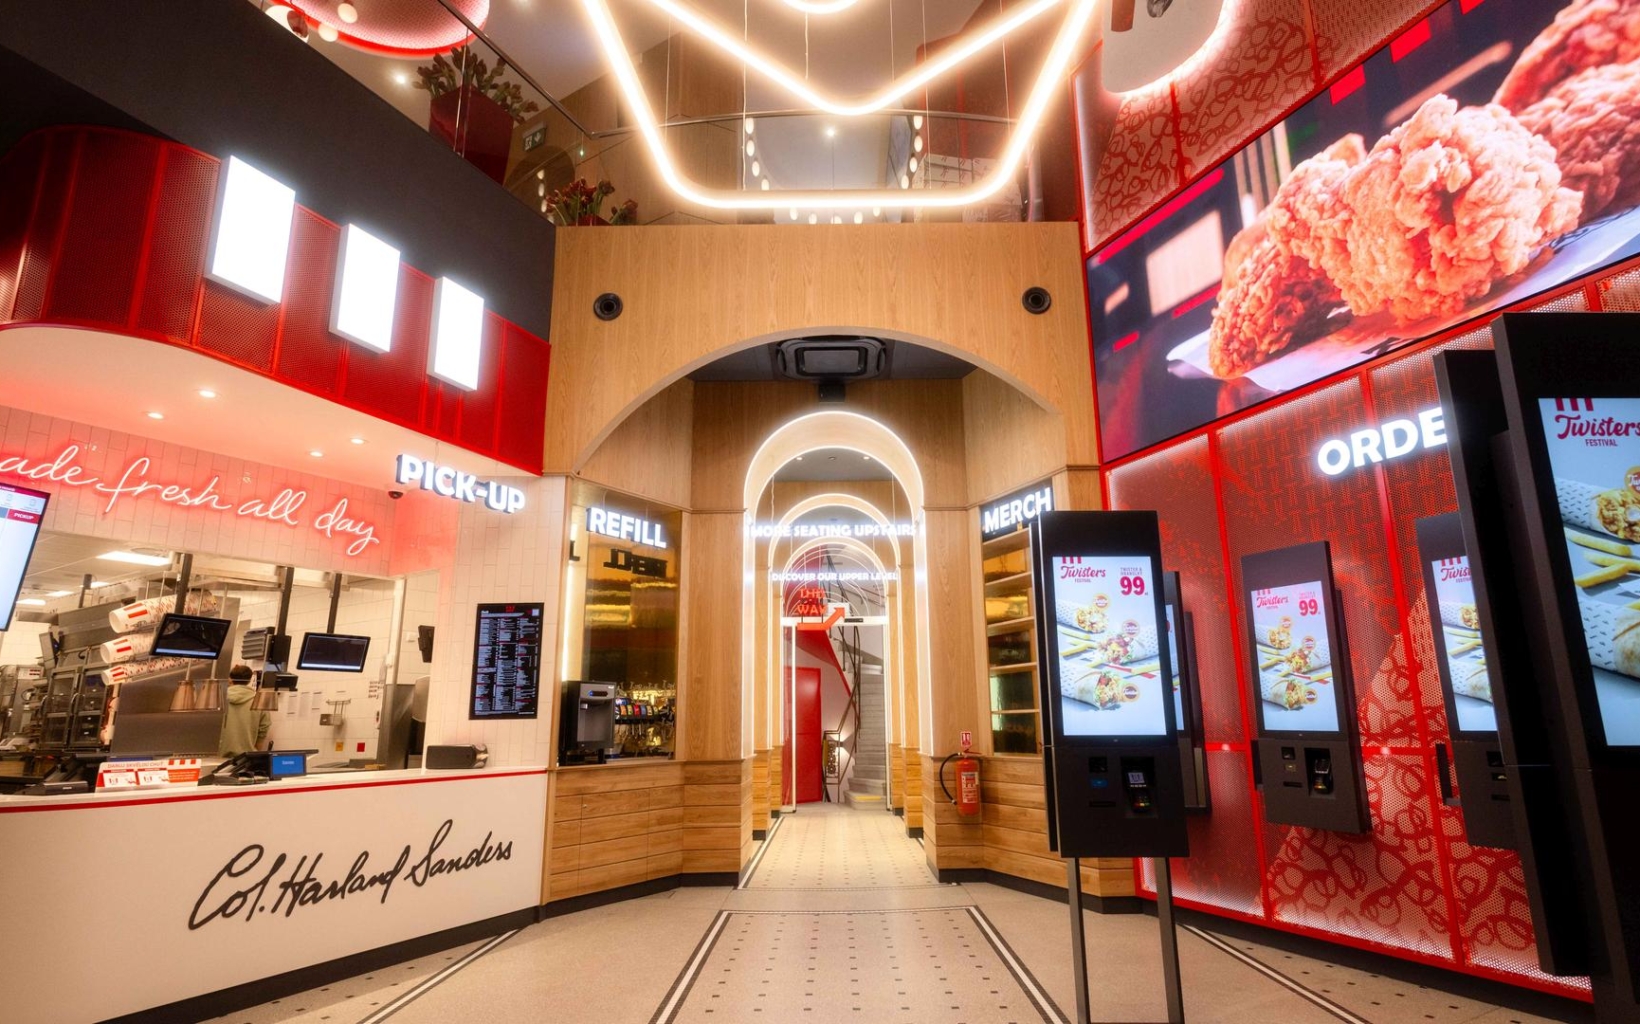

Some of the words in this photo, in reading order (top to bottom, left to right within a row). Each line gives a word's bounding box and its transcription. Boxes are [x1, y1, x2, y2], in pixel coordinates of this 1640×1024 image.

[1555, 414, 1640, 440] Twisters
[1318, 407, 1448, 475] ORDE
[1584, 439, 1618, 447] FESTIVAL
[396, 453, 526, 514] PICK-UP
[96, 457, 232, 513] fresh
[237, 488, 306, 526] all
[314, 498, 380, 556] day
[984, 486, 1052, 534] MERCH
[586, 506, 667, 549] REFILL
[750, 524, 792, 537] MORE
[793, 524, 852, 537] SEATING
[854, 524, 917, 537] UPSTAIRS
[771, 572, 817, 581] DISCOVER
[817, 572, 838, 581] OUR
[839, 572, 869, 581] UPPER
[870, 572, 898, 581] LEVEL
[1060, 565, 1107, 579] Twisters
[1120, 576, 1145, 596] 99
[1256, 595, 1289, 608] Twisters
[1298, 598, 1319, 617] 99
[188, 844, 265, 930] Col.
[271, 845, 411, 917] Harland
[404, 819, 513, 887] Sanders
